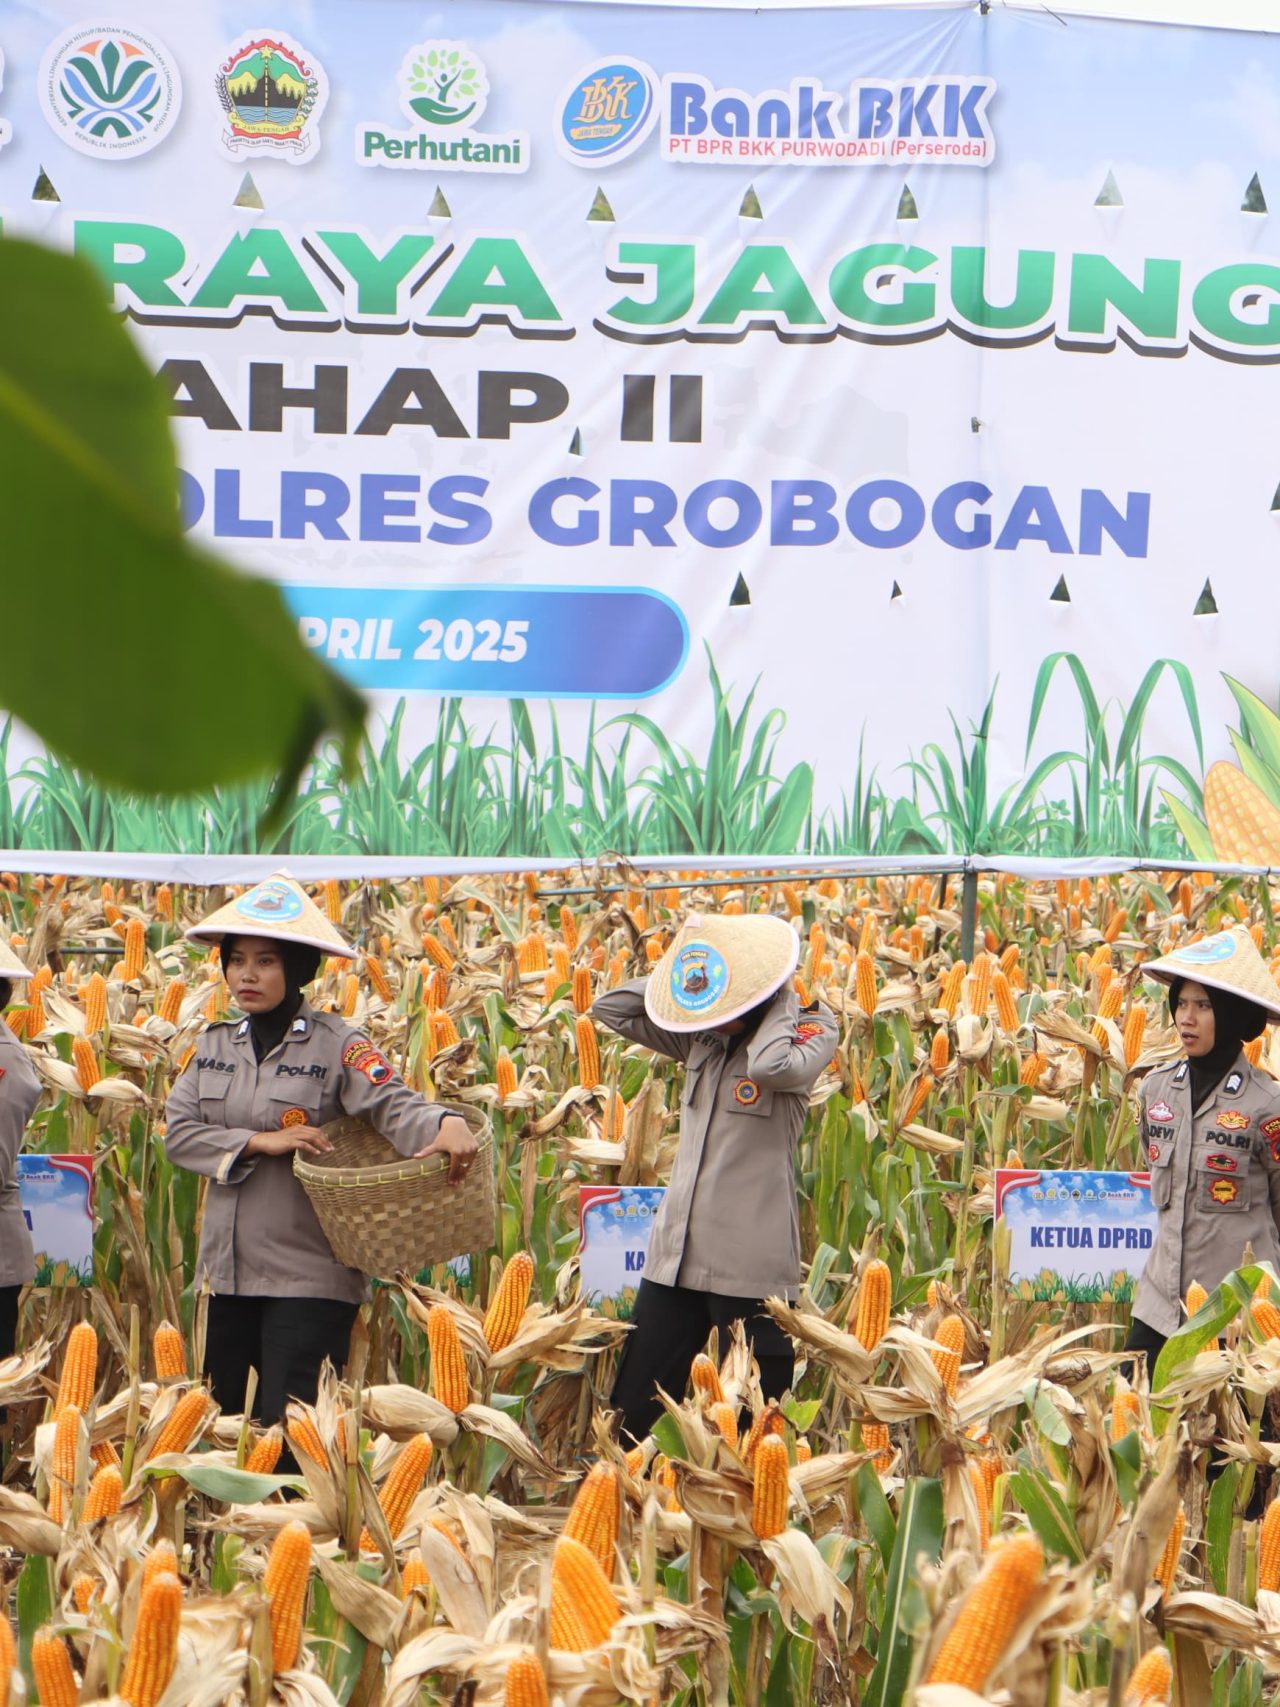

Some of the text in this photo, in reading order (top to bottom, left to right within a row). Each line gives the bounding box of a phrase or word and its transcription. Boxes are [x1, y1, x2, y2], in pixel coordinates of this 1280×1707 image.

[49, 40, 73, 79] LINGKUNGAN
[153, 112, 169, 132] HIDUP
[670, 82, 987, 139] Bank BKK
[74, 131, 147, 149] REPUBLIK INDONESIA
[364, 131, 520, 164] Perhutani
[669, 138, 987, 158] PT BPR BKK PURWODADI (Perseroda)
[74, 220, 564, 321] RAYA
[155, 358, 703, 443] AHAP II
[176, 466, 1151, 559] LRES GROBOGAN
[298, 616, 530, 663] PRIL 2025
[276, 1064, 327, 1079] POLRI
[1206, 1131, 1250, 1149] POLRI
[1031, 1226, 1153, 1249] KETUA DPRD
